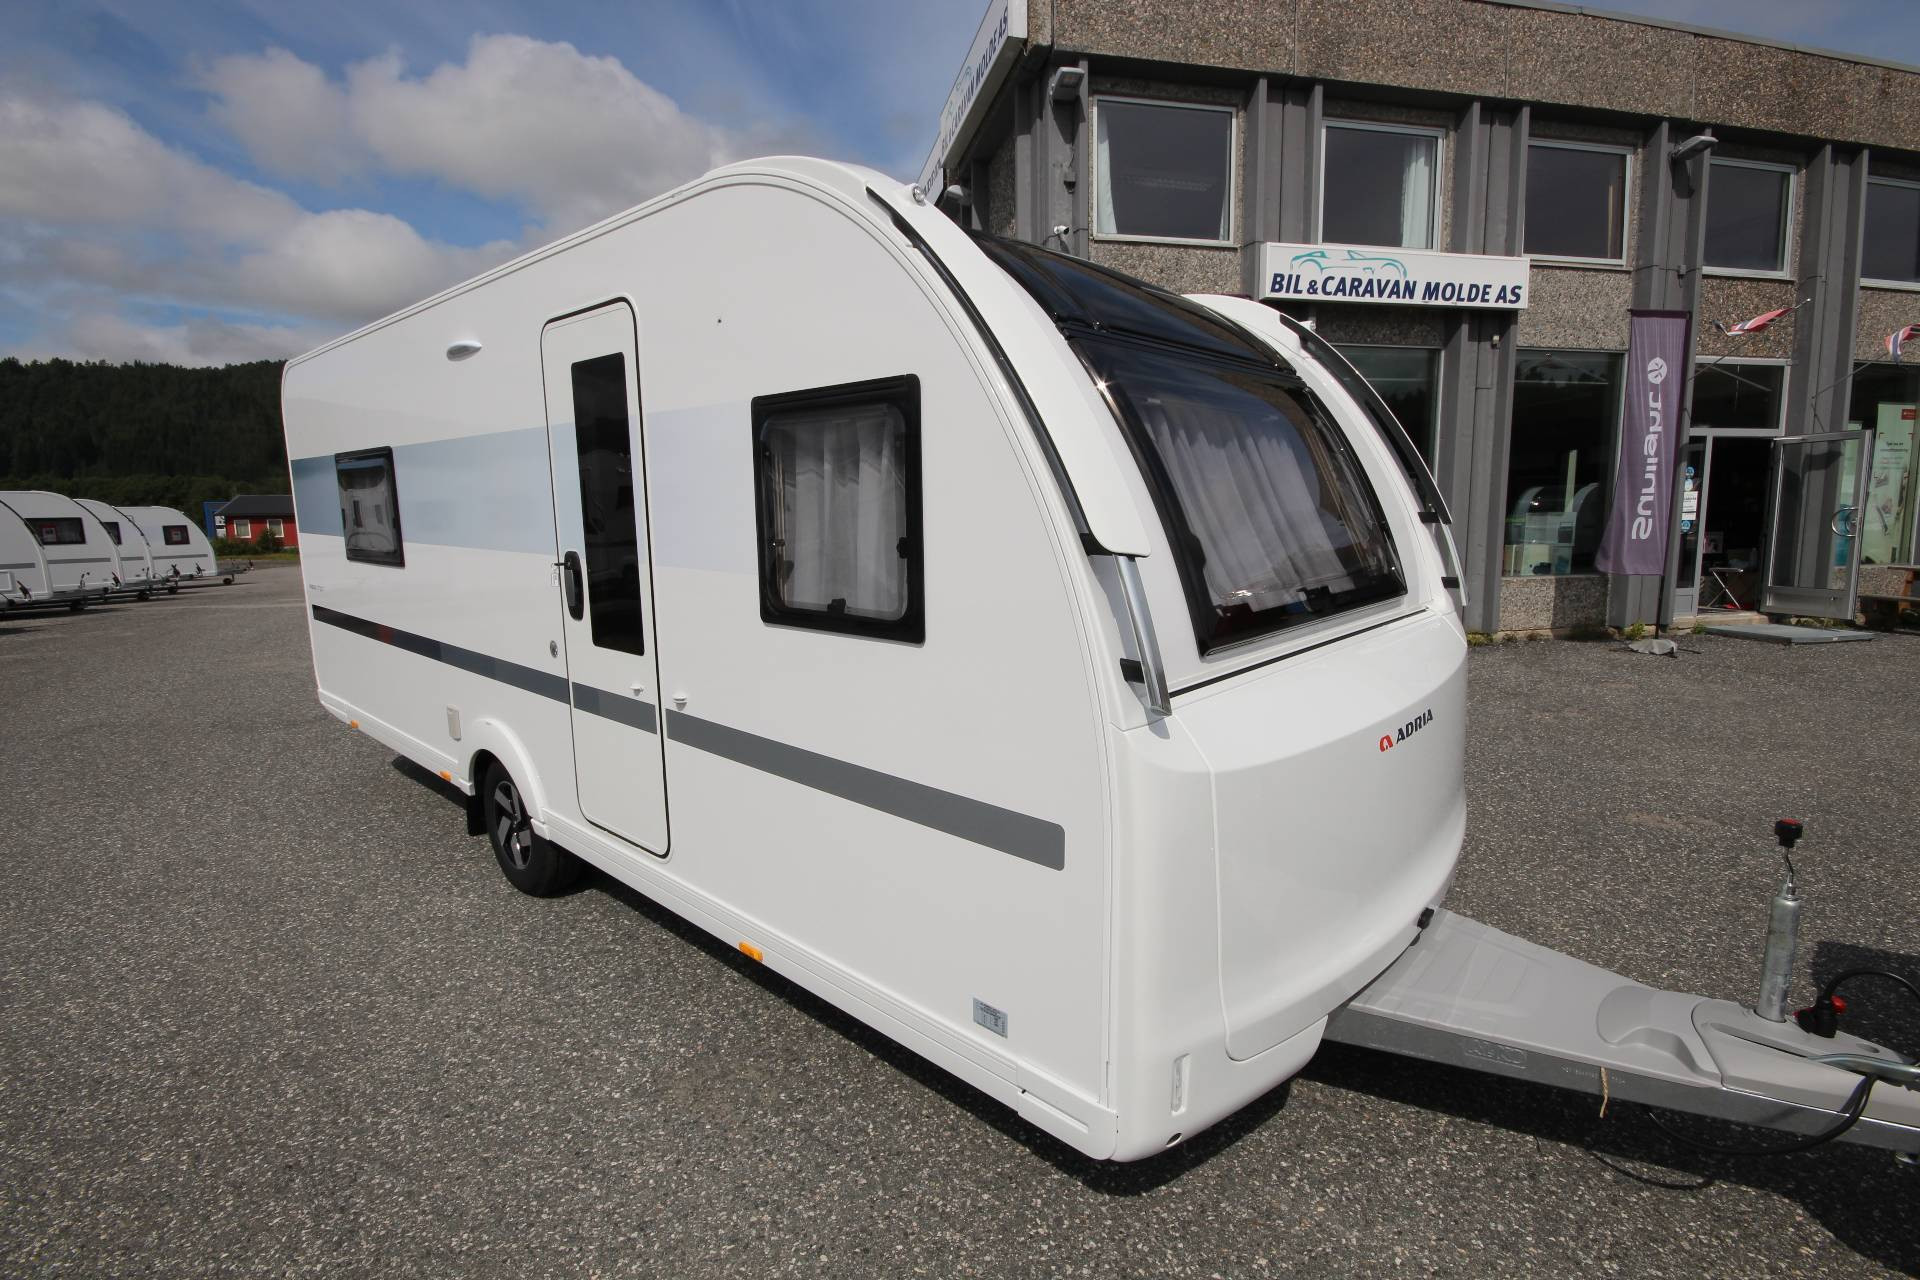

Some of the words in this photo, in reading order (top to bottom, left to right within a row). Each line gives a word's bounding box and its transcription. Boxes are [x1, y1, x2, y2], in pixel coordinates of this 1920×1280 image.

[997, 6, 1008, 45] AS
[1270, 273, 1303, 294] BIL
[1306, 279, 1319, 295] &
[1321, 275, 1417, 300] CARAVAN
[1422, 281, 1492, 304] MOLDE
[1494, 285, 1522, 305] AS
[1396, 708, 1433, 744] ADRIA
